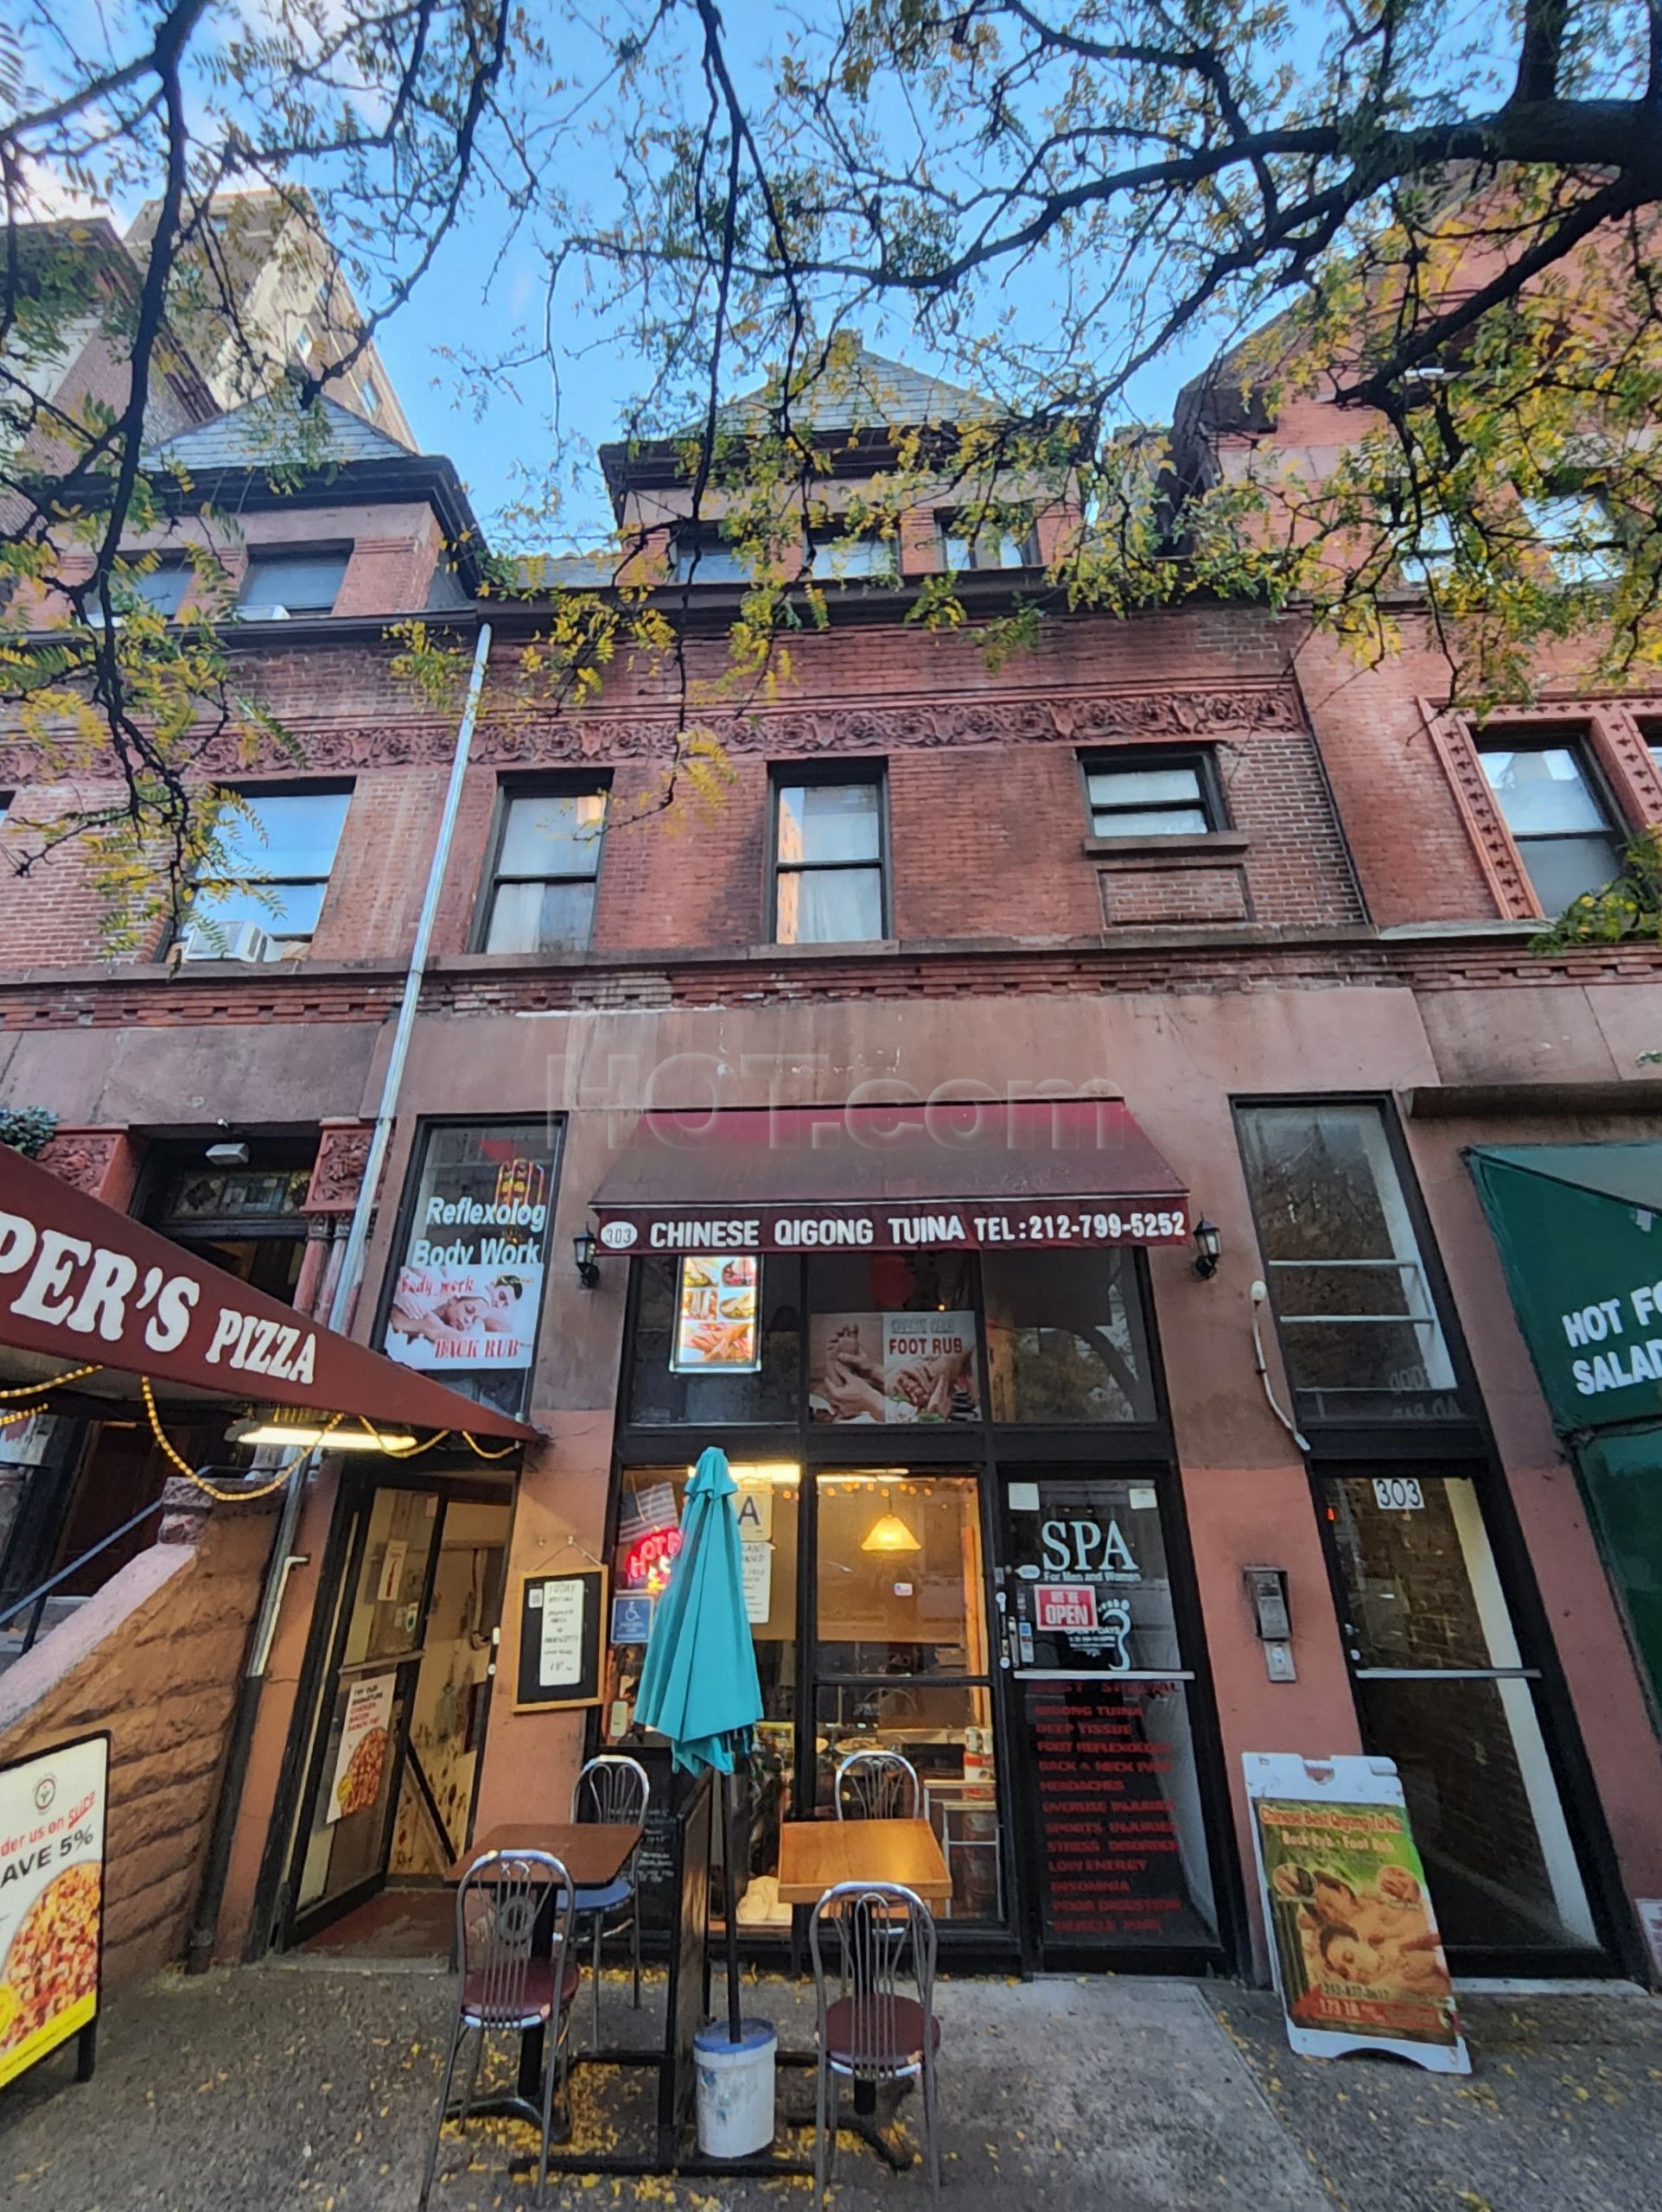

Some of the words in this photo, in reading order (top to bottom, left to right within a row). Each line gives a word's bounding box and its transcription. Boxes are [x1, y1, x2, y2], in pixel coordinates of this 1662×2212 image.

[426, 1197, 546, 1232] Reflexolog
[605, 1228, 632, 1244] 303
[650, 1220, 760, 1247] CHINESE
[774, 1218, 873, 1245] QIGONG
[888, 1215, 965, 1244] TUINA
[411, 1238, 474, 1264] Body
[481, 1237, 540, 1264] Work
[1562, 1298, 1623, 1348] HOT
[205, 1308, 316, 1384] PIZZA
[435, 1339, 477, 1358] BACK
[484, 1339, 519, 1358] RUB
[888, 1338, 927, 1355] FOOT
[933, 1338, 963, 1355] RUB
[1377, 1479, 1421, 1507] 303
[737, 1496, 761, 1526] A
[631, 1535, 666, 1578] HOT
[1041, 1520, 1139, 1571] SPA
[1044, 1571, 1060, 1582] For
[1062, 1571, 1084, 1582] Men
[1085, 1571, 1103, 1582] and
[1104, 1571, 1142, 1582] Women
[1045, 1605, 1089, 1625] OPEN
[29, 1826, 44, 1844] us
[48, 1817, 64, 1834] on
[1, 1844, 52, 1888] AVE
[60, 1824, 93, 1858] 5%
[1048, 1859, 1083, 1872] LOW
